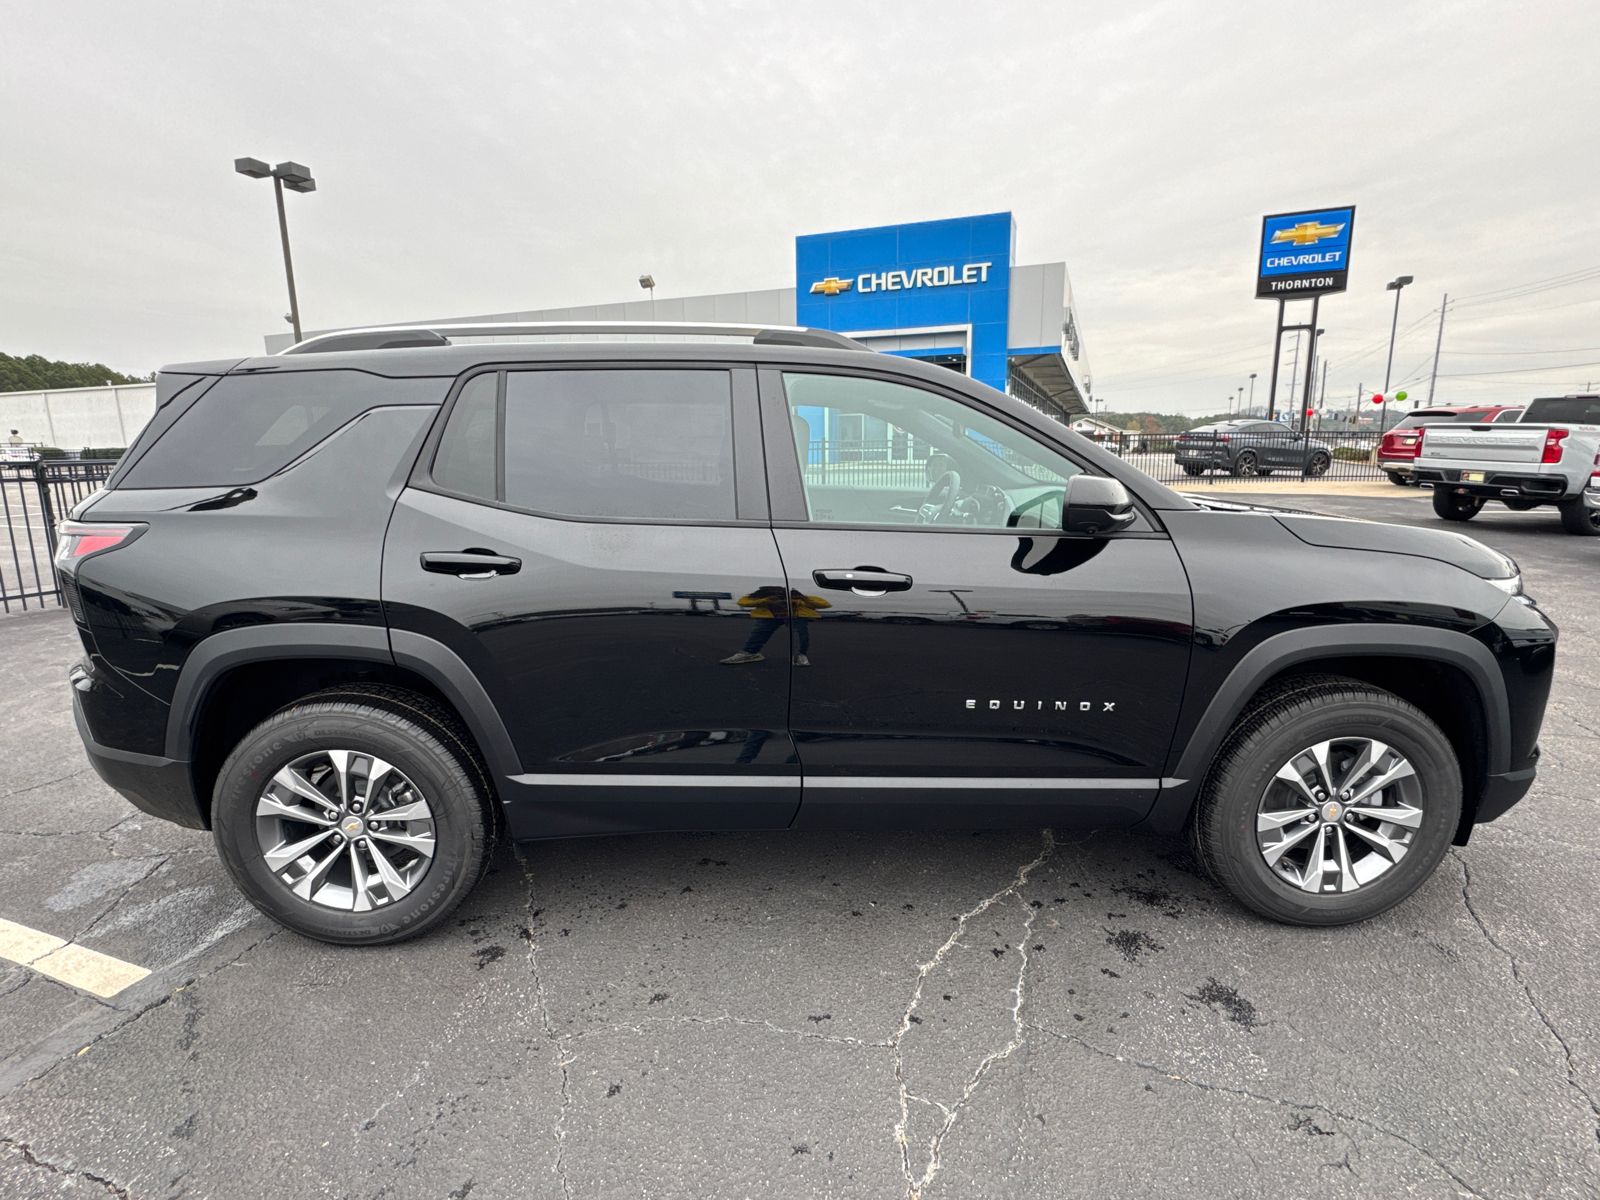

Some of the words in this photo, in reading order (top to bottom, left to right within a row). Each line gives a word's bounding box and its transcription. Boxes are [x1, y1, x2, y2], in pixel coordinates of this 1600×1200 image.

[1266, 251, 1342, 268] CHEVROLET
[857, 262, 992, 293] CHEVROLET
[1270, 277, 1334, 290] THORNTON
[1427, 436, 1536, 446] CHEVROLET
[965, 699, 1116, 712] EQUINOX
[402, 861, 457, 924] Firestone
